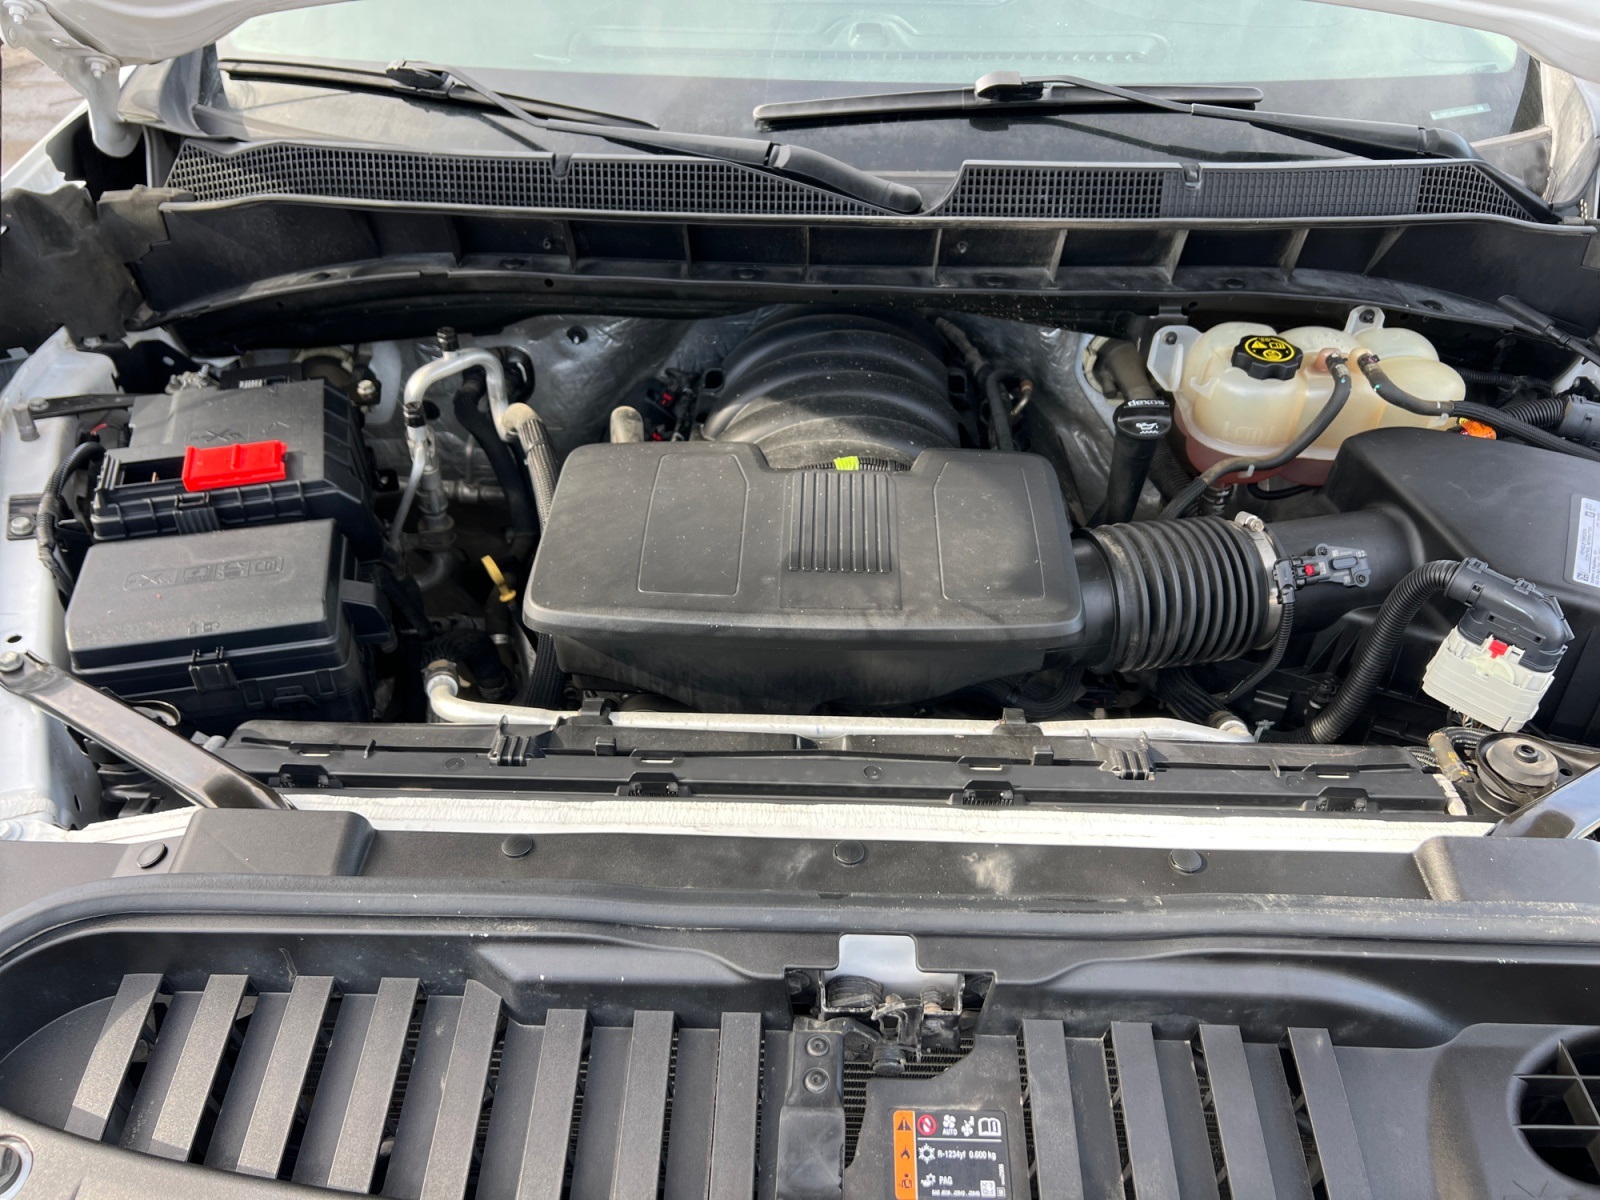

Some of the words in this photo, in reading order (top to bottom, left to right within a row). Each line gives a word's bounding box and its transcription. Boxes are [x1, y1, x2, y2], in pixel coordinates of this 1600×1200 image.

[1127, 399, 1165, 407] dexos
[942, 1128, 957, 1136] AUTO
[937, 1149, 966, 1160] R-1234yf
[987, 1150, 997, 1161] kg
[939, 1175, 953, 1186] PAG
